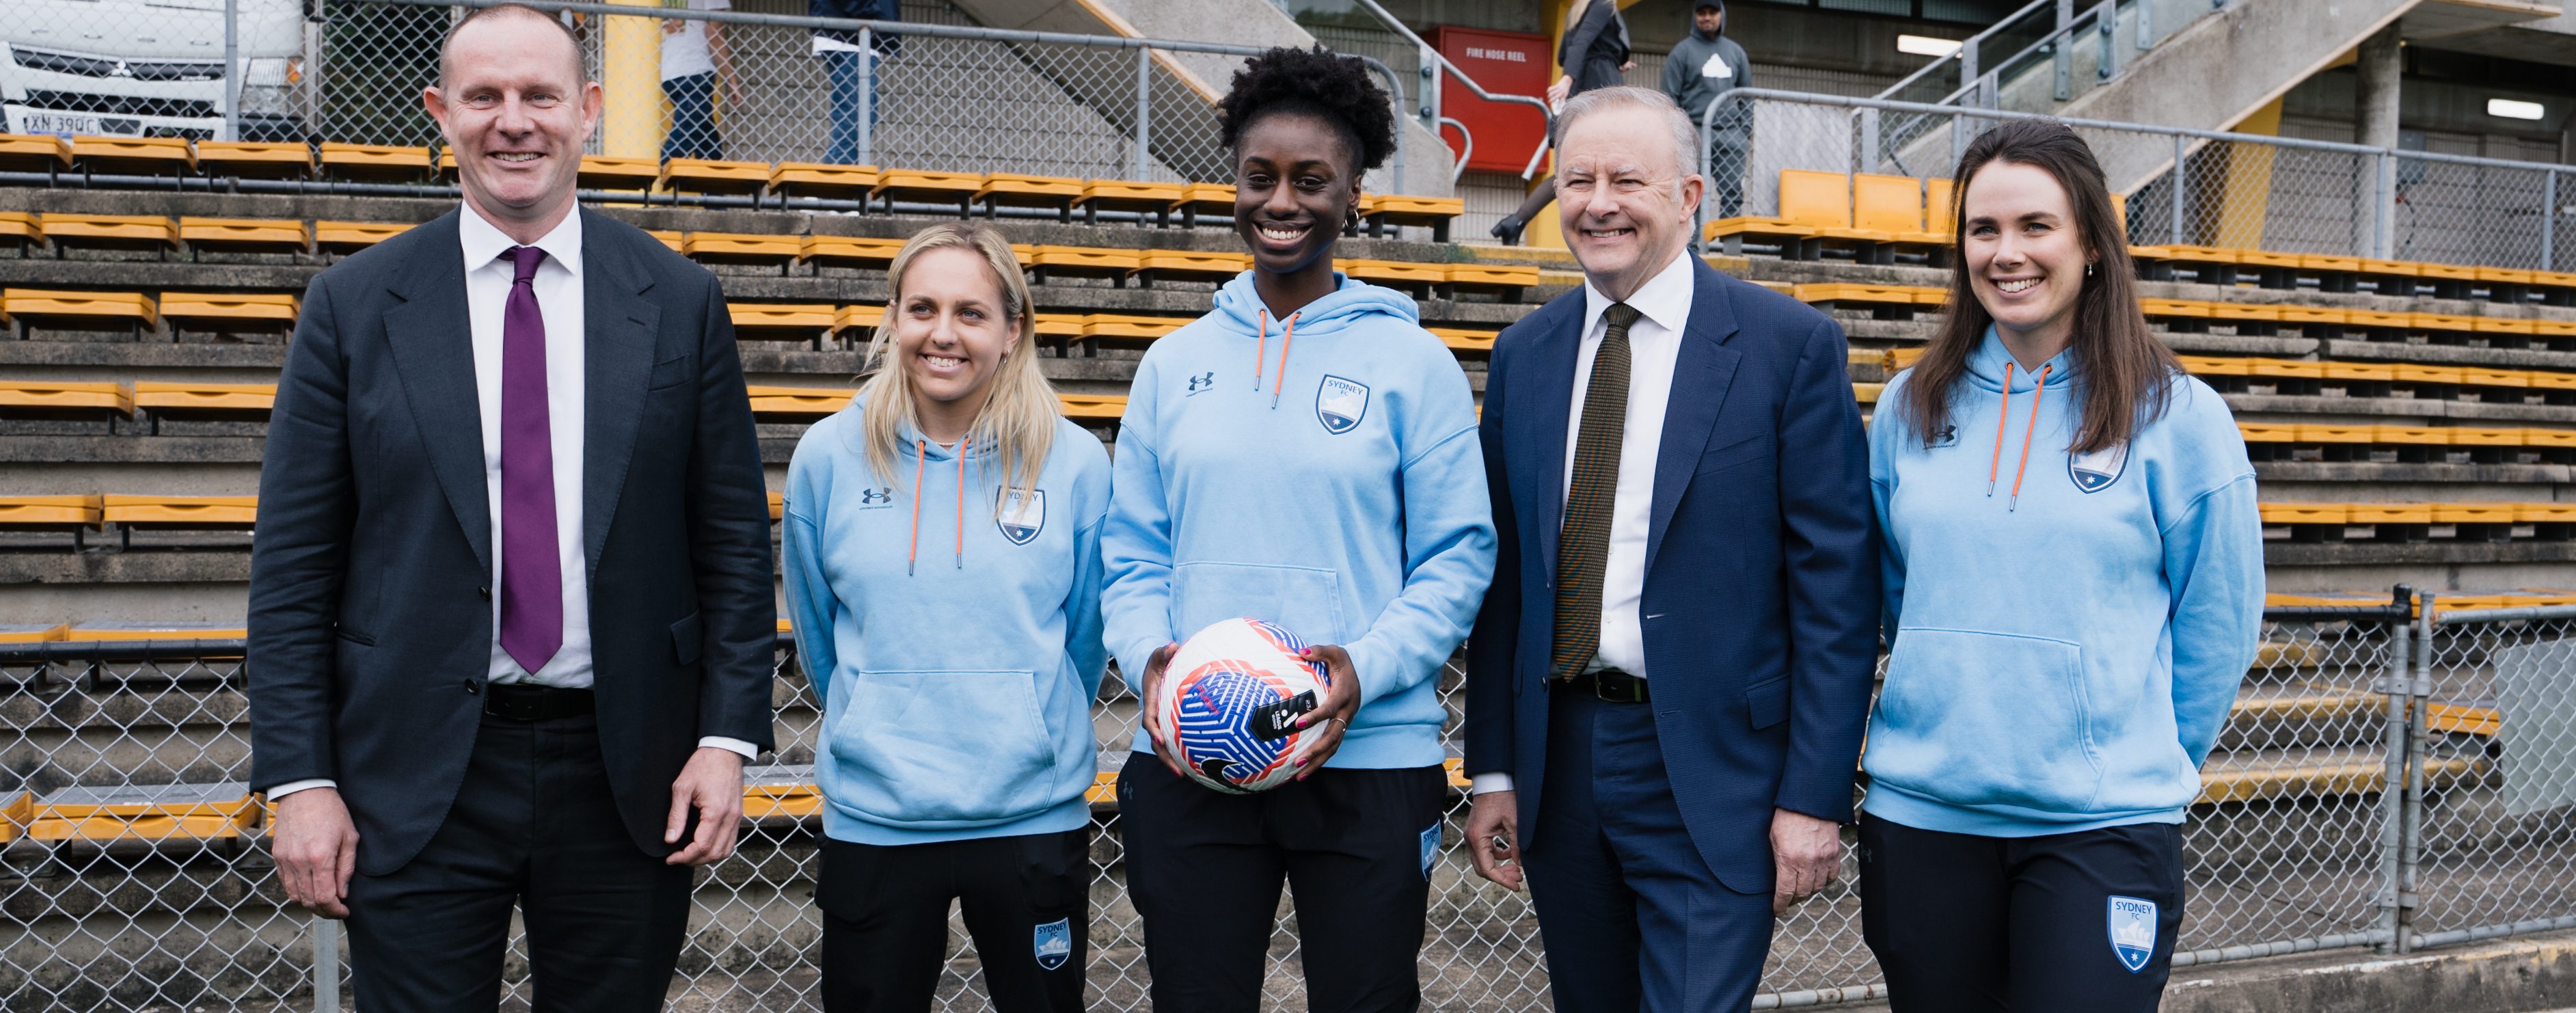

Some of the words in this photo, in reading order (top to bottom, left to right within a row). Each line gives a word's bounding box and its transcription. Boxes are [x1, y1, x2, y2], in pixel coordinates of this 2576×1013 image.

[1466, 47, 1484, 59] FIRE
[1485, 49, 1506, 61] HOSE
[1507, 51, 1526, 62] REEL
[31, 114, 51, 132] XN
[1328, 380, 1363, 395] SYDNEY
[1003, 491, 1038, 501] YDY
[1424, 827, 1439, 843] SYDNE
[2116, 902, 2152, 915] SYDNEY
[1038, 921, 1066, 934] SYDNEY
